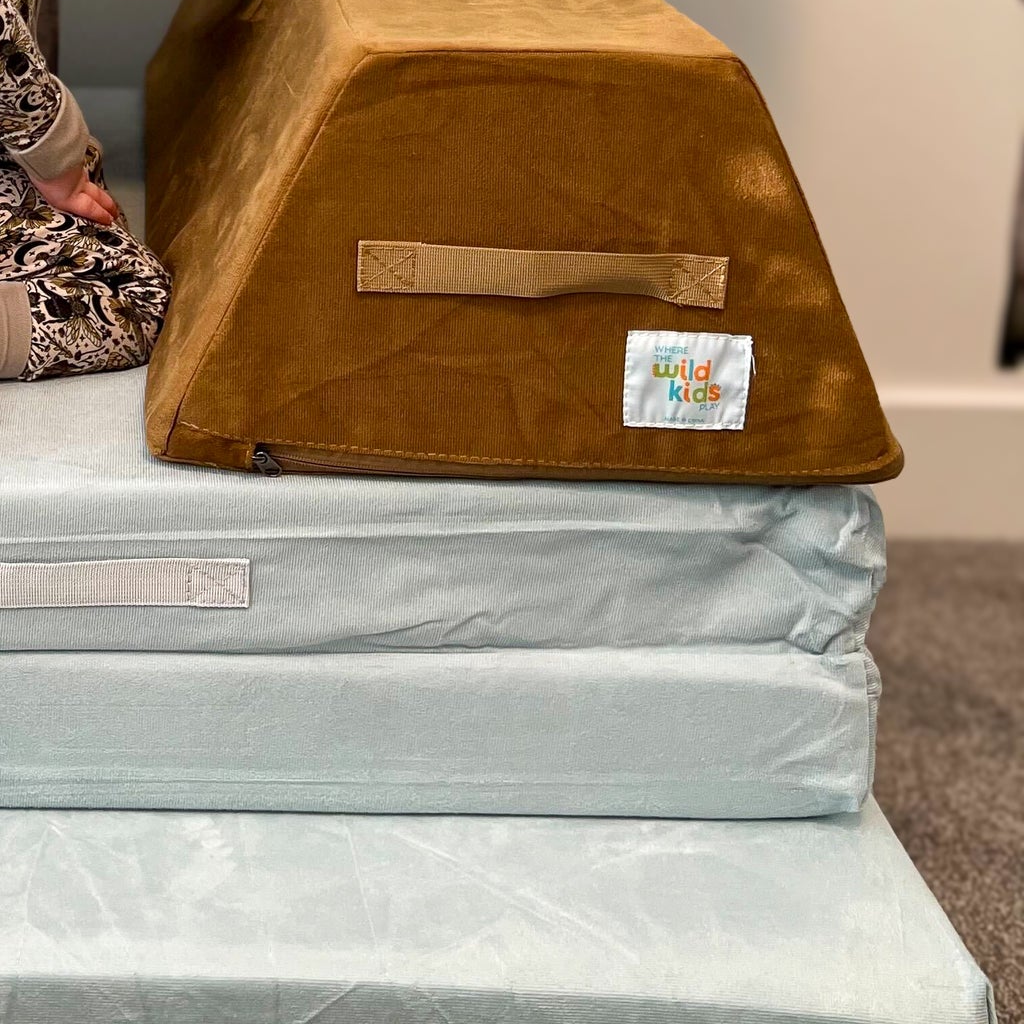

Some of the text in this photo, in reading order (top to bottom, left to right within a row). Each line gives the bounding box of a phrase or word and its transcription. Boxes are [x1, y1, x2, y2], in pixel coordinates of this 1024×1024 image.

[654, 345, 689, 355] WHERE
[654, 354, 672, 363] THE
[652, 359, 711, 381] wild
[668, 380, 721, 403] kids
[699, 403, 720, 411] PLAY
